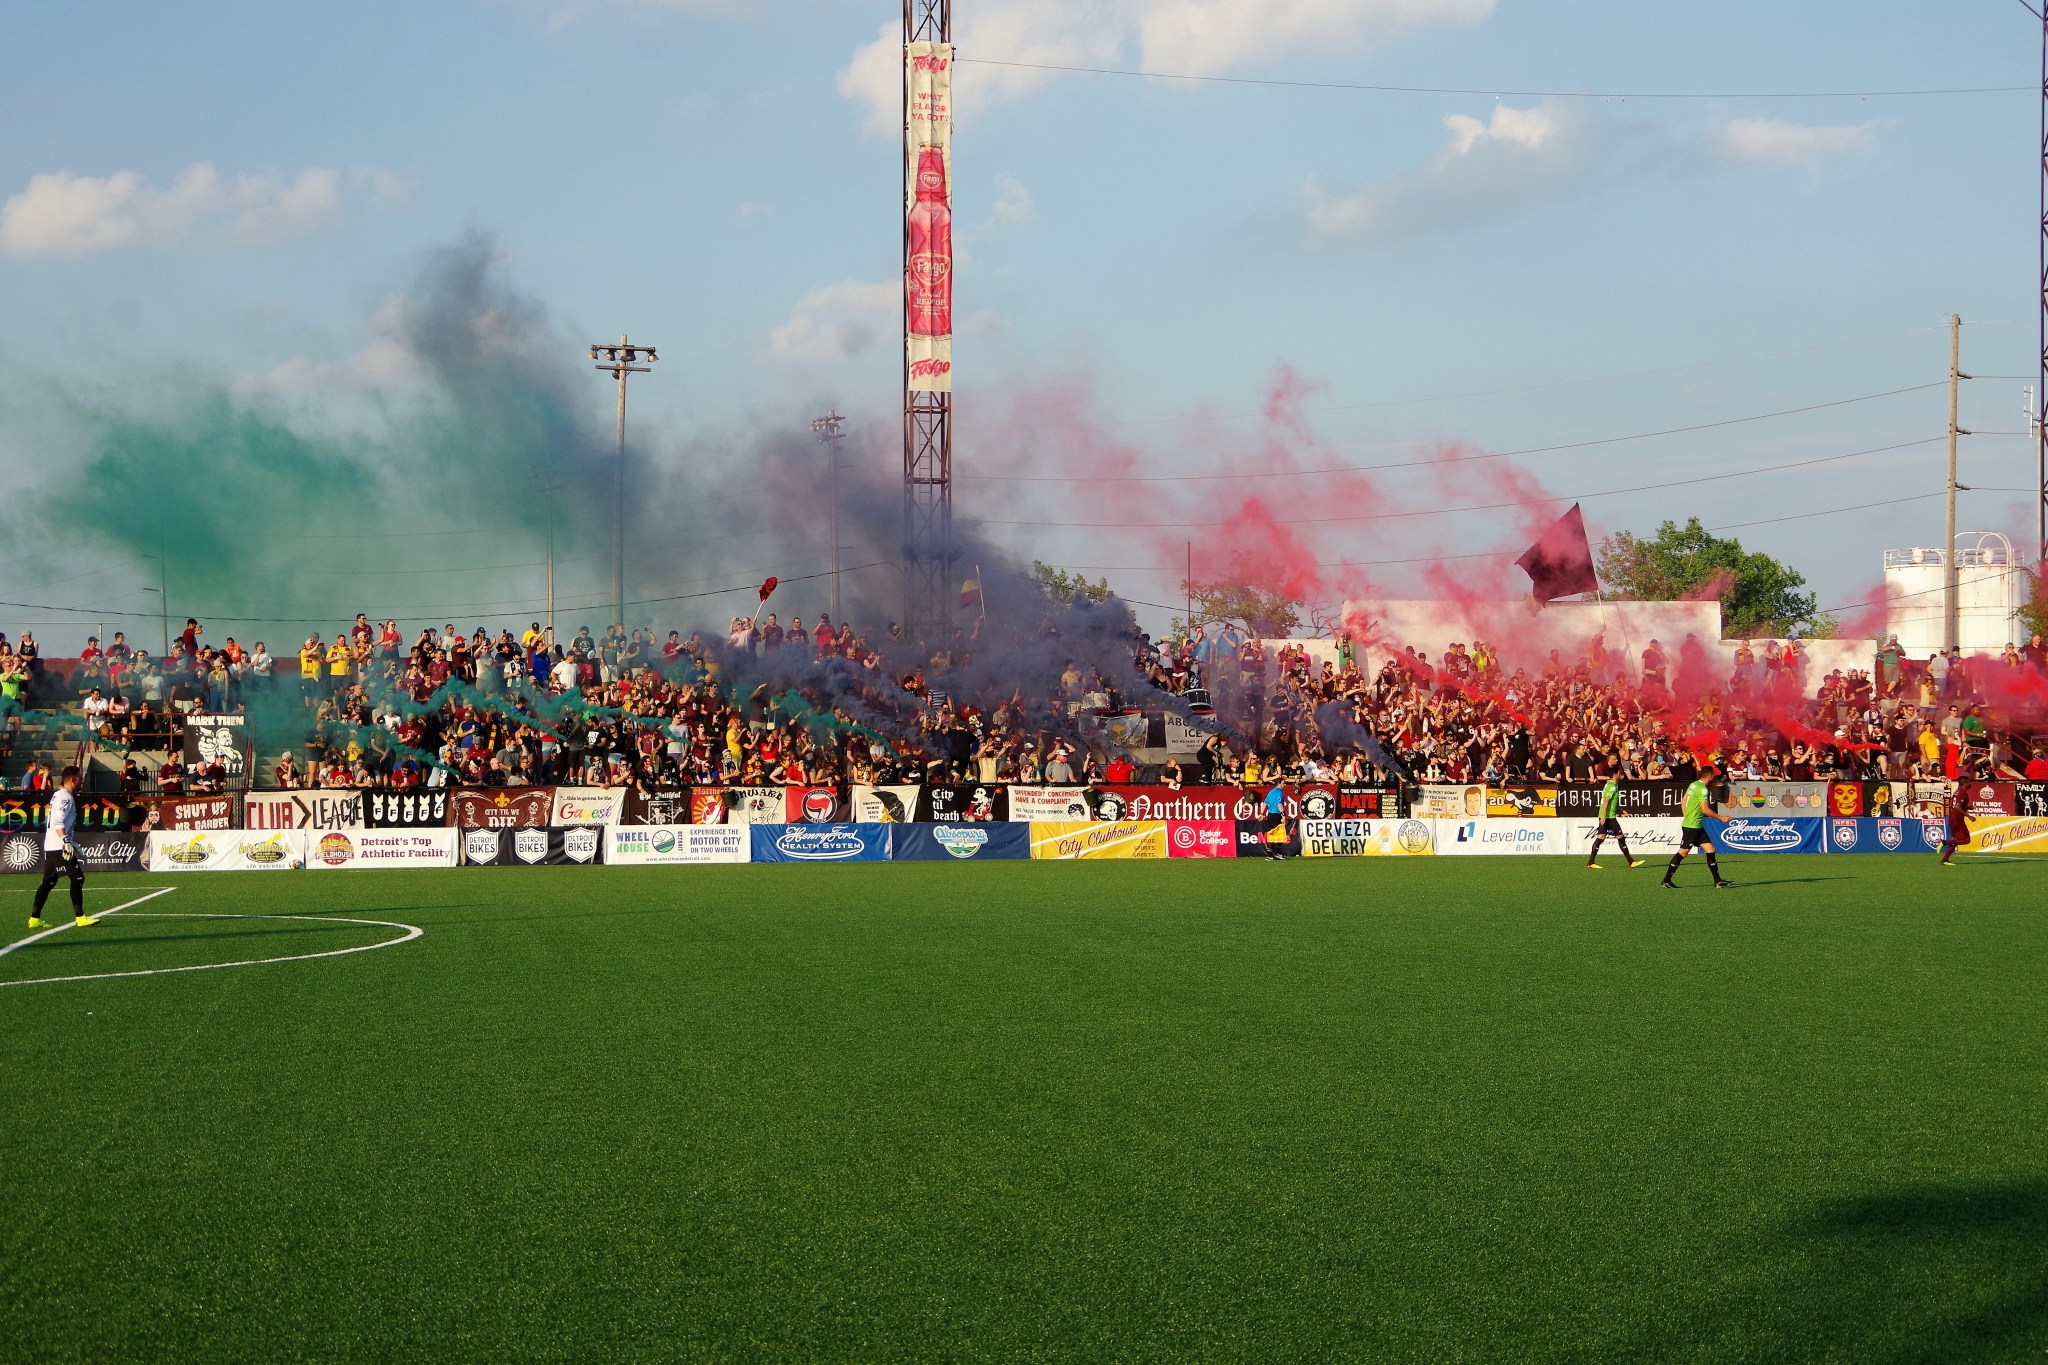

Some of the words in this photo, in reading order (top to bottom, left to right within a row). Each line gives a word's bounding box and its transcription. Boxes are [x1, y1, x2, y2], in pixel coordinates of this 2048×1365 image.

[918, 92, 944, 102] WHAT
[911, 112, 924, 121] YA
[926, 112, 950, 122] GOT?
[916, 258, 945, 277] Faygo
[186, 715, 216, 726] MARK
[216, 715, 245, 726] THEM
[1184, 728, 1203, 738] ICE
[1014, 789, 1046, 797] OFFENDED?
[2016, 783, 2046, 792] FAMILY
[931, 788, 954, 801] City
[1558, 789, 1650, 807] NORTERN
[932, 800, 943, 810] til
[1341, 794, 1377, 809] HATE
[1489, 796, 1505, 806] 20
[1542, 796, 1556, 808] 12
[175, 803, 208, 820] SHUT
[211, 801, 228, 815] UP
[374, 807, 381, 815] F
[390, 809, 397, 817] F
[405, 810, 412, 819] F
[421, 809, 428, 817] F
[484, 808, 498, 816] CITY
[511, 808, 520, 816] WE
[560, 803, 612, 820] Gayest
[1126, 794, 1226, 821] Northern
[1234, 796, 1299, 821] Gud
[0, 797, 120, 833] Gurd
[312, 798, 362, 830] LEAGUE
[933, 810, 960, 822] death
[175, 821, 191, 830] MR
[1306, 821, 1371, 838] CERVEZA
[1729, 819, 1768, 836] Henry
[1766, 818, 1795, 835] Ford
[616, 832, 649, 842] WHEEL
[786, 826, 829, 844] Henry
[828, 825, 859, 842] Ford
[1199, 829, 1222, 837] Baker
[1638, 829, 1683, 846] City
[1981, 832, 2005, 850] City
[2009, 822, 2048, 840] Clubhou
[361, 837, 408, 846] Detroit's
[411, 837, 432, 846] Top
[690, 836, 720, 846] MOTOR
[722, 836, 742, 846] CITY
[823, 841, 861, 849] SYSTEM
[1058, 839, 1083, 858] City
[1087, 825, 1138, 847] Clubhouse
[1199, 836, 1229, 845] College
[108, 841, 137, 862] City
[469, 843, 495, 853] BIKES
[519, 843, 545, 853] BIKES
[568, 842, 594, 852] BIKES
[616, 843, 649, 853] HOUSE
[1312, 839, 1367, 855] DELRAY
[1515, 844, 1542, 852] BANK
[361, 850, 404, 858] Athletic
[408, 849, 450, 858] Facility
